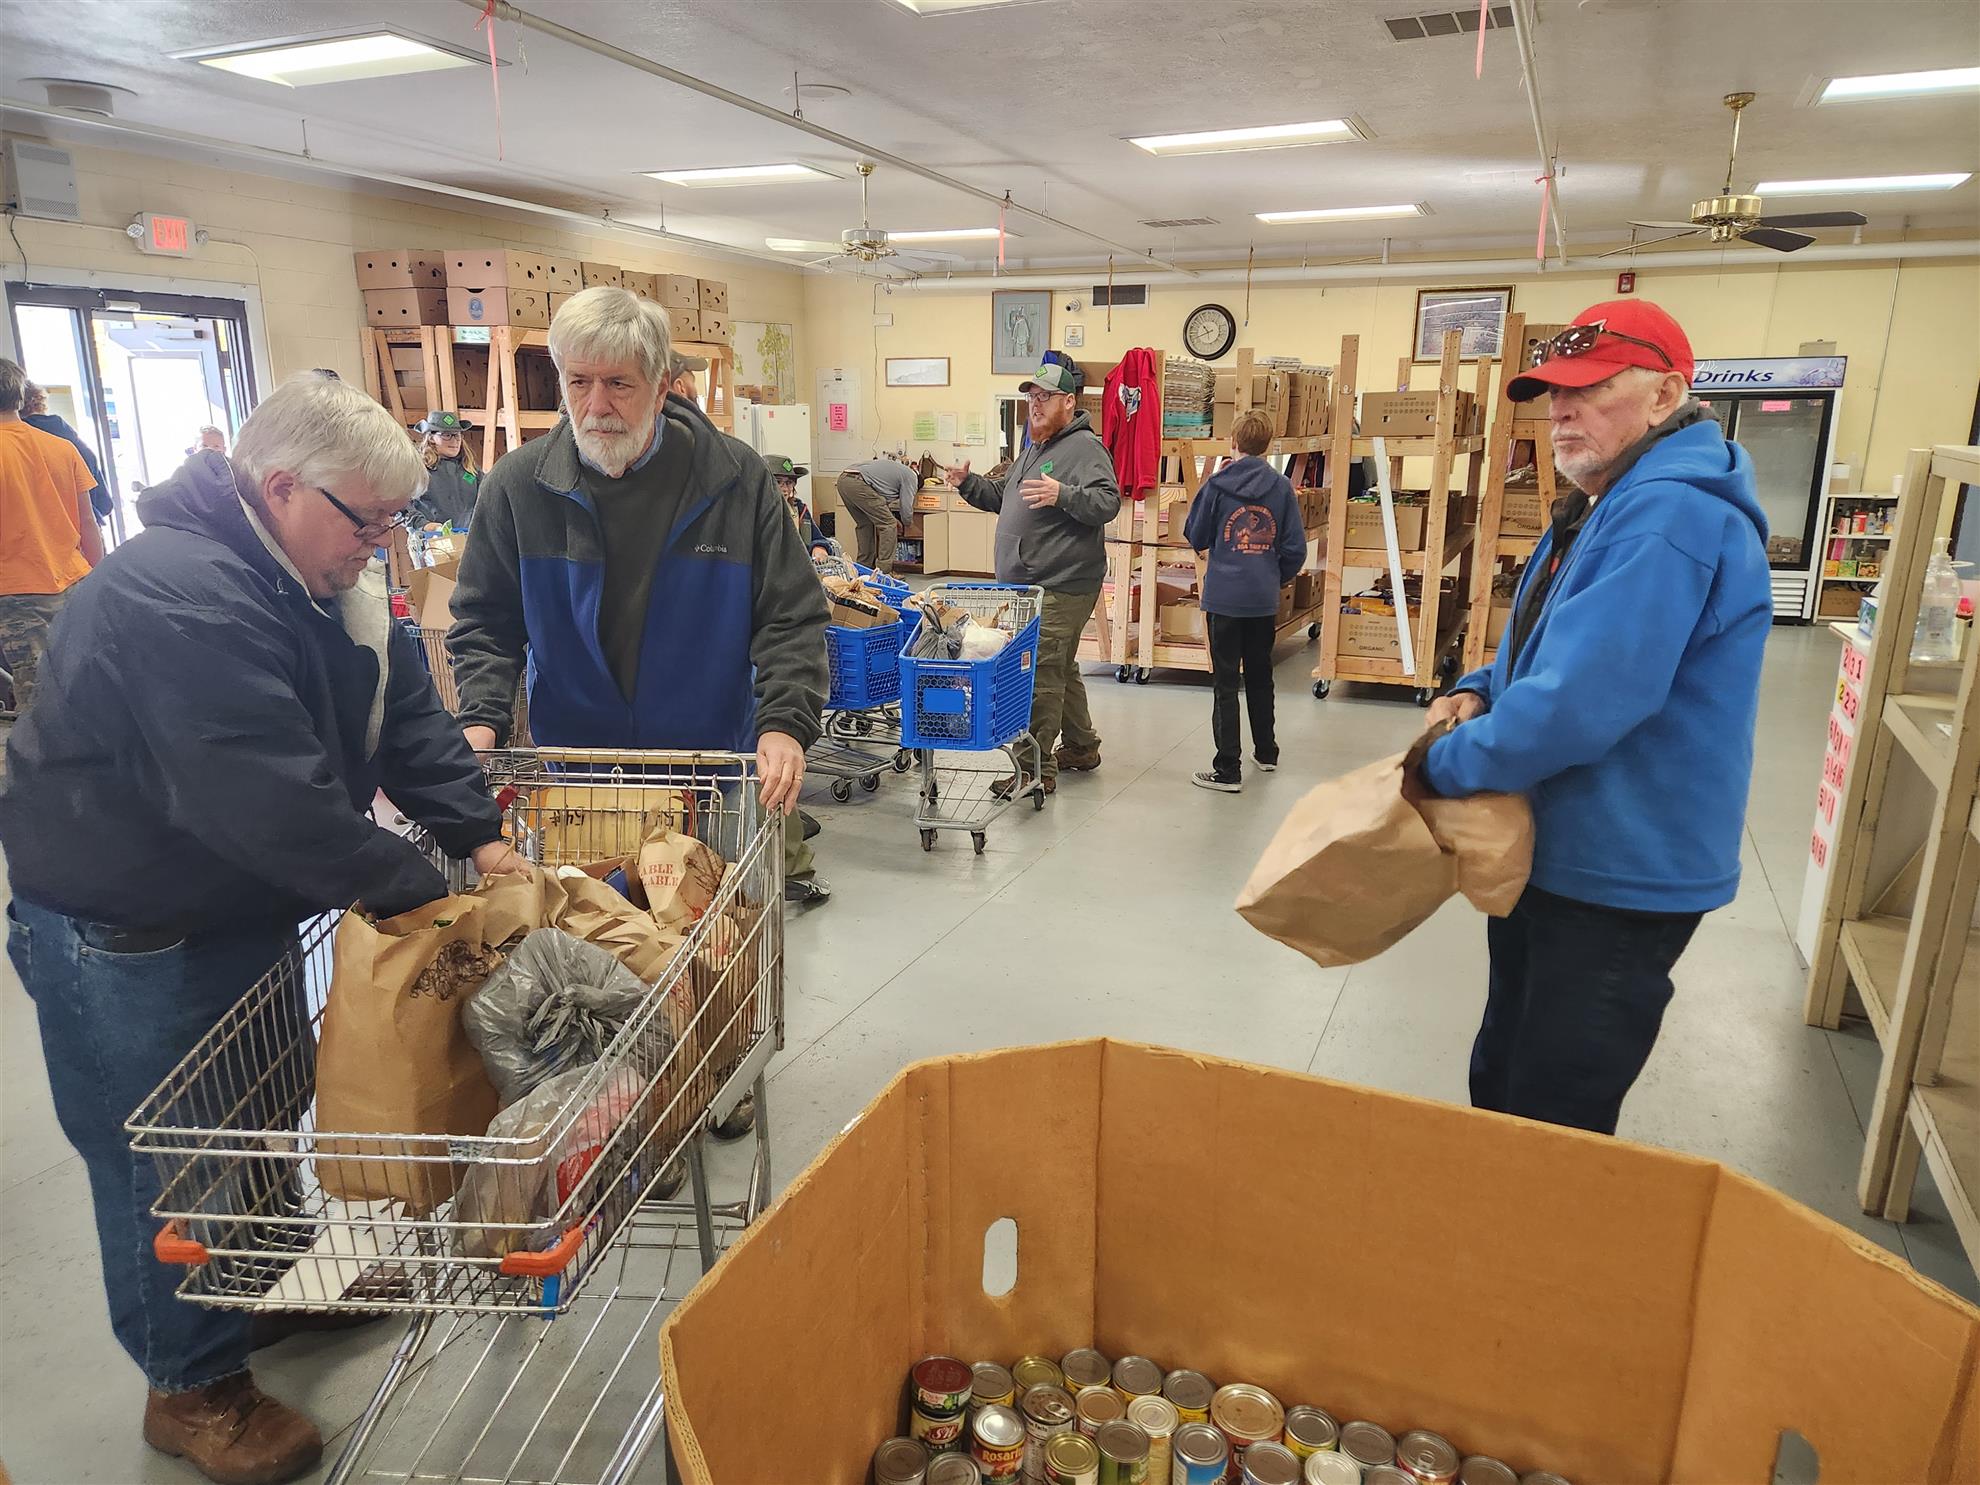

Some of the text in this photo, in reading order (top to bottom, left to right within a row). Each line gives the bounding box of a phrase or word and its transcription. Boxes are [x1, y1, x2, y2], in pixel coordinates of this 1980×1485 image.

[152, 217, 187, 250] EXIT
[1693, 369, 1774, 383] Drinks
[1839, 683, 1857, 719] 223
[644, 876, 679, 887] ABLE
